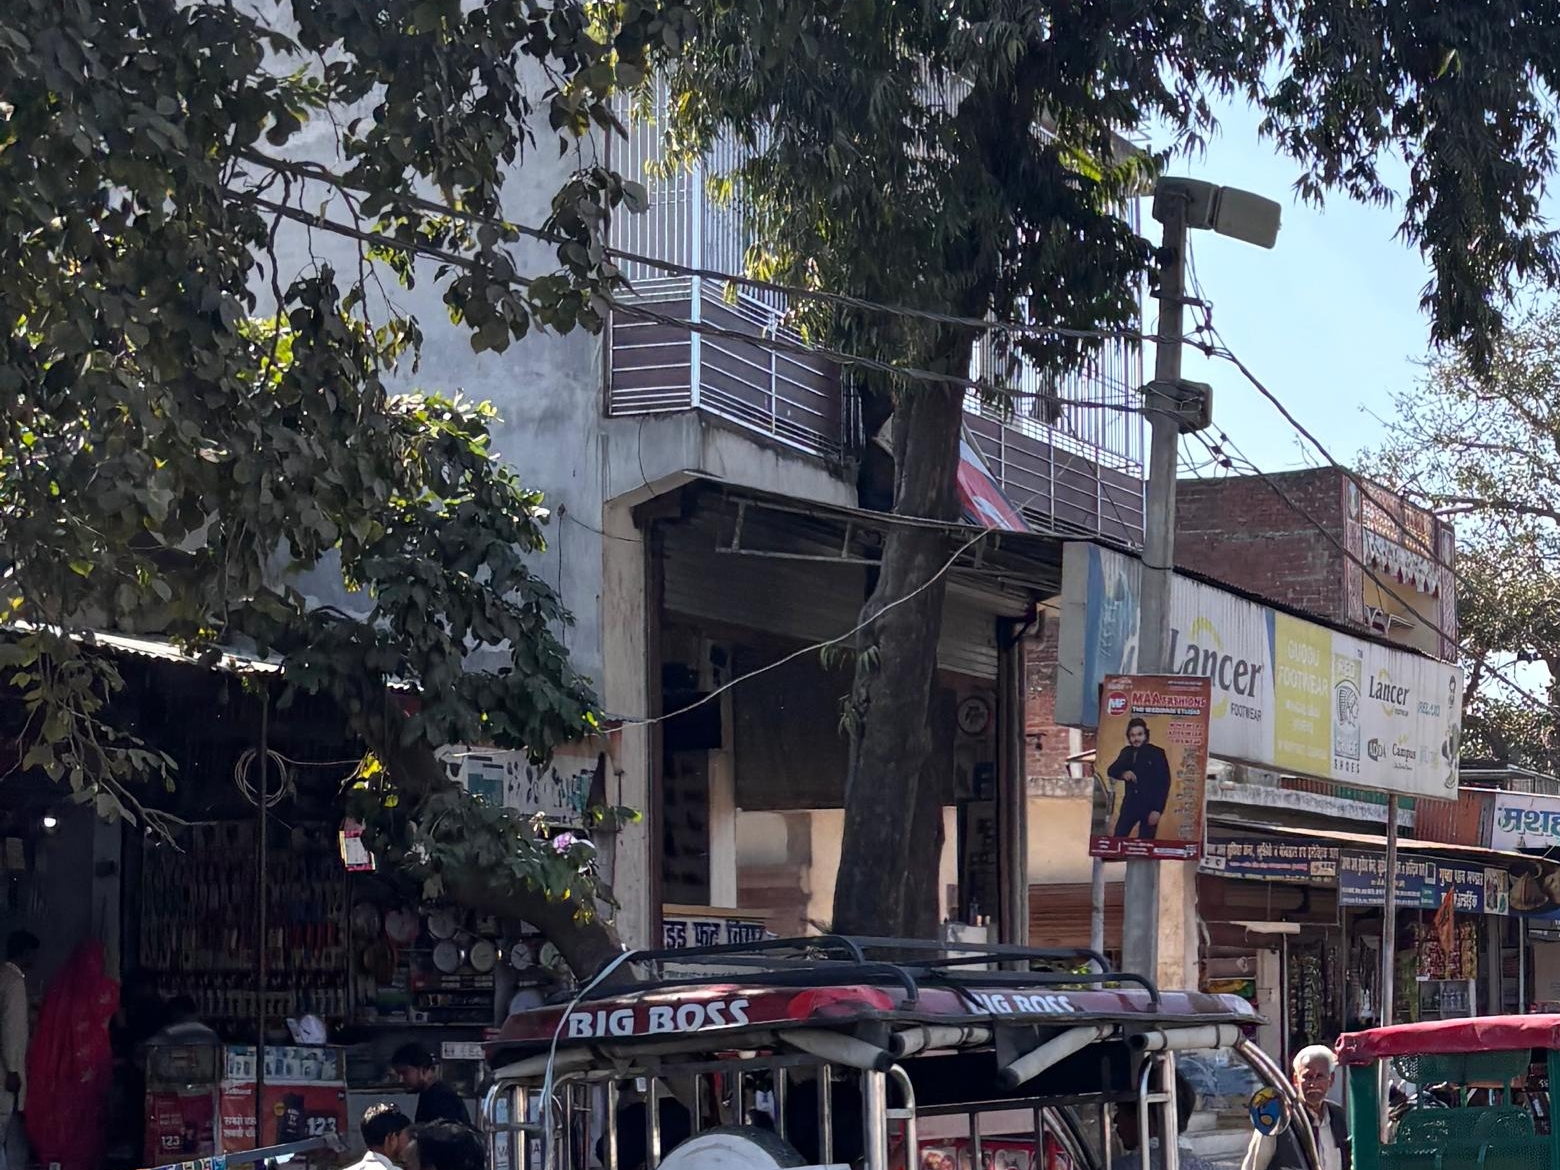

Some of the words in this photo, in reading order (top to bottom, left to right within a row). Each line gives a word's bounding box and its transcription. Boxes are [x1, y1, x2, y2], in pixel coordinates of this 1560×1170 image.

[1170, 627, 1262, 698] Lancer
[1368, 674, 1410, 707] Lancer
[1230, 701, 1263, 722] FOOTWEAR
[1334, 758, 1360, 774] SHOES
[1392, 743, 1417, 763] Campus
[568, 1008, 634, 1038] BIG
[648, 999, 750, 1034] BOSS
